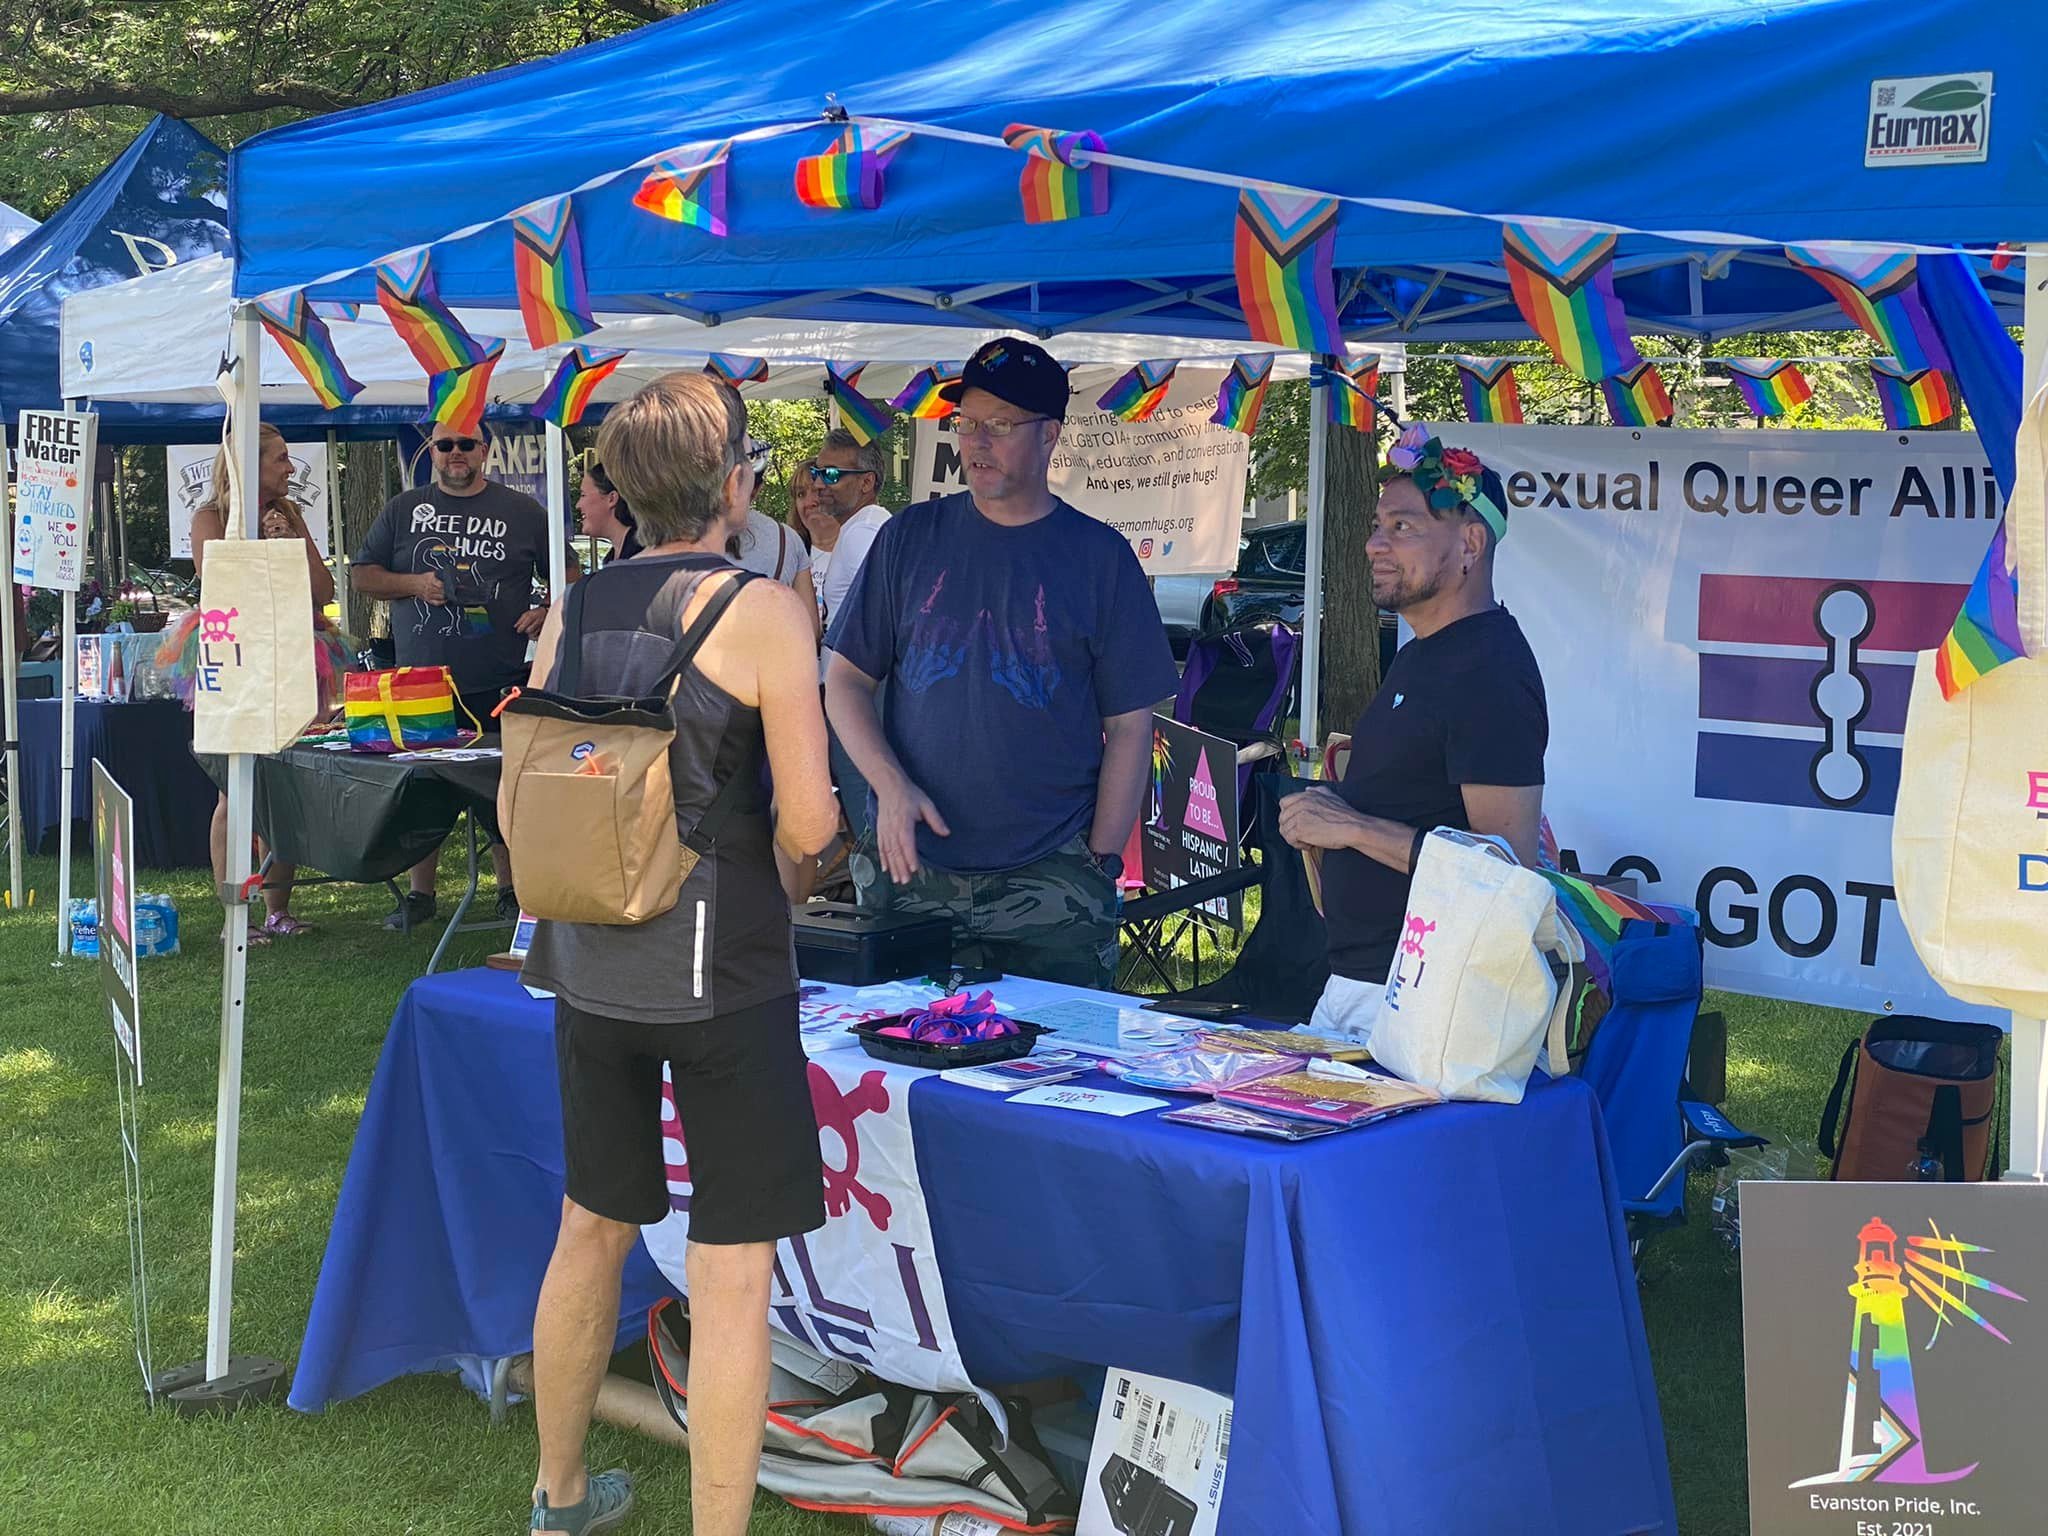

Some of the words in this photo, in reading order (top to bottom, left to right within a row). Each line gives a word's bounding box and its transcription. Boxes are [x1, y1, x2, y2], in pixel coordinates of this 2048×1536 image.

[1870, 113, 1977, 148] Eurmax
[1063, 412, 1118, 429] powering
[1167, 407, 1183, 419] to
[1186, 394, 1219, 414] cele
[26, 414, 80, 446] FREE
[1134, 422, 1202, 446] community
[24, 439, 81, 464] Water
[1096, 454, 1160, 470] education,
[1163, 446, 1184, 462] and
[20, 480, 52, 500] STAY
[1086, 476, 1109, 490] And
[1110, 478, 1134, 494] yes,
[1137, 476, 1149, 488] we
[1152, 472, 1170, 487] still
[1171, 470, 1191, 489] give
[1193, 466, 1218, 485] hugs!
[1506, 460, 1659, 512] exual
[1683, 461, 1872, 517] Queer
[1889, 466, 1997, 520] Alli
[48, 522, 62, 533] WE
[410, 514, 463, 534] FREE
[466, 516, 507, 538] DAD
[454, 537, 506, 562] HUGS
[1189, 777, 1217, 800] PROUD
[1189, 803, 1201, 821] TO
[1182, 830, 1222, 863] HISPANIC
[1696, 866, 1896, 967] GOT
[1809, 1494, 1889, 1512] Evanston
[1894, 1497, 1945, 1516] Pride,
[1949, 1499, 1981, 1515] Inc.
[1892, 1523, 1933, 1536] 2021
